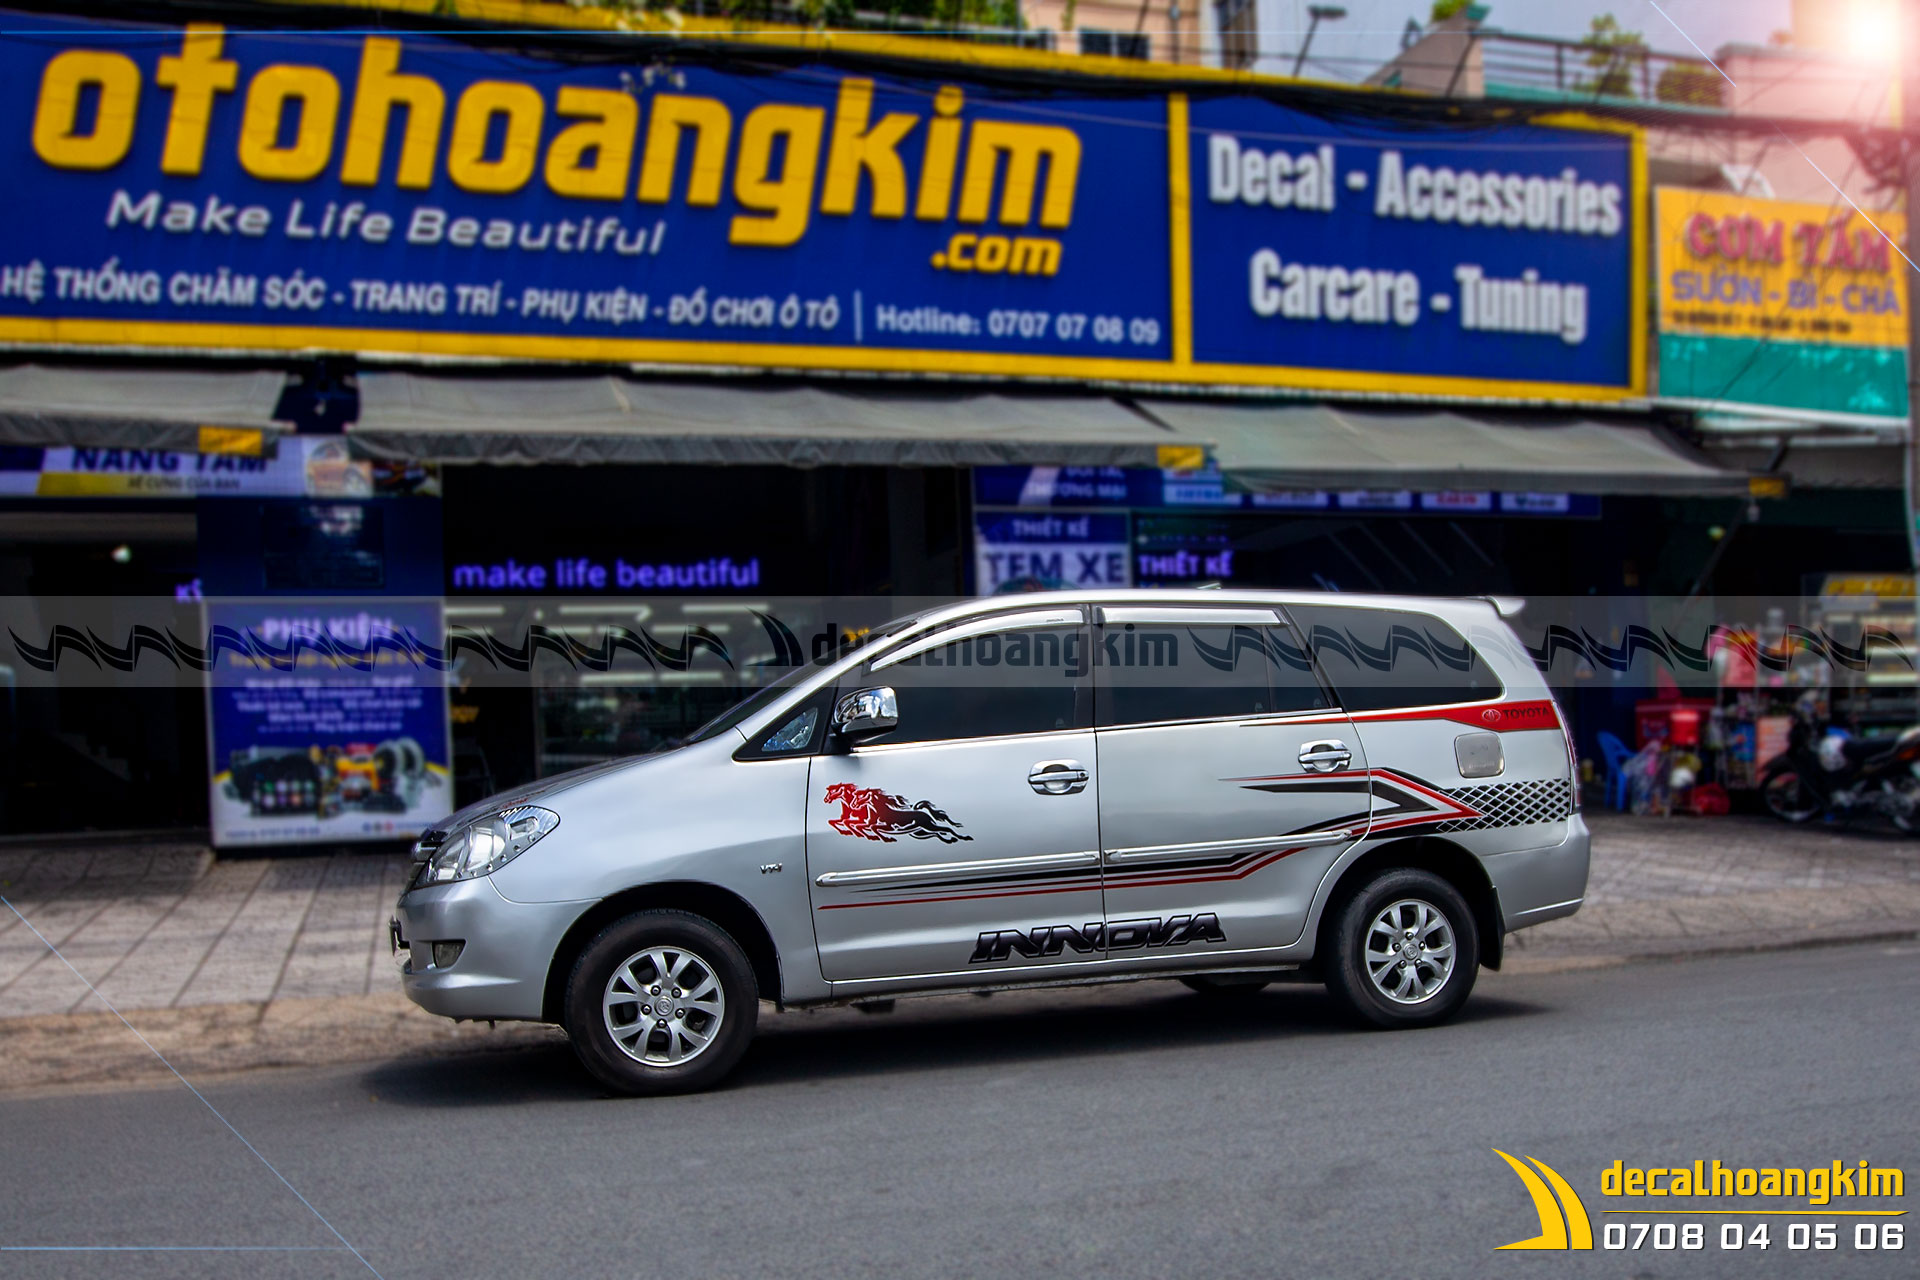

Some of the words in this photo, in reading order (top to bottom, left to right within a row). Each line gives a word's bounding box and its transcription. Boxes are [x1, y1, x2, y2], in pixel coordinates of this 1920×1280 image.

[33, 24, 1081, 247] otohoangkim
[1208, 133, 1335, 212] Decal
[1375, 150, 1622, 236] Accessories
[105, 189, 271, 236] Make
[285, 198, 392, 243] Life
[406, 206, 667, 256] Beautiful
[1686, 211, 1784, 267] CƠM
[931, 233, 1063, 276] .com
[1, 260, 45, 302] HỆ
[54, 257, 162, 303] THỐNG
[169, 267, 257, 307] CHĂM
[264, 269, 327, 309] SÓC
[350, 281, 446, 315] TRANG
[455, 281, 502, 317] TRÍ
[521, 288, 579, 325] PHỤ
[584, 287, 649, 326] KIỆN
[711, 296, 774, 328] CHƠI
[779, 294, 799, 328] Ô
[805, 296, 840, 330] TÔ
[1249, 247, 1421, 327] Carcare
[1454, 263, 1588, 345] Tuning
[876, 304, 981, 336] Hotline:
[988, 309, 1050, 338] 0707
[1056, 313, 1088, 340] 07
[1093, 315, 1124, 343] 08
[1130, 318, 1161, 346] 09
[1012, 518, 1062, 538] THIẾT
[1067, 516, 1089, 537] KẾ
[453, 559, 547, 588] make
[556, 557, 608, 588] life
[616, 557, 760, 588] beautiful
[1077, 551, 1126, 584] XE
[1139, 550, 1199, 576] THIẾT
[1205, 550, 1234, 577] KẾ
[1502, 707, 1549, 719] TOYOTA
[968, 912, 1226, 964] INNOVA
